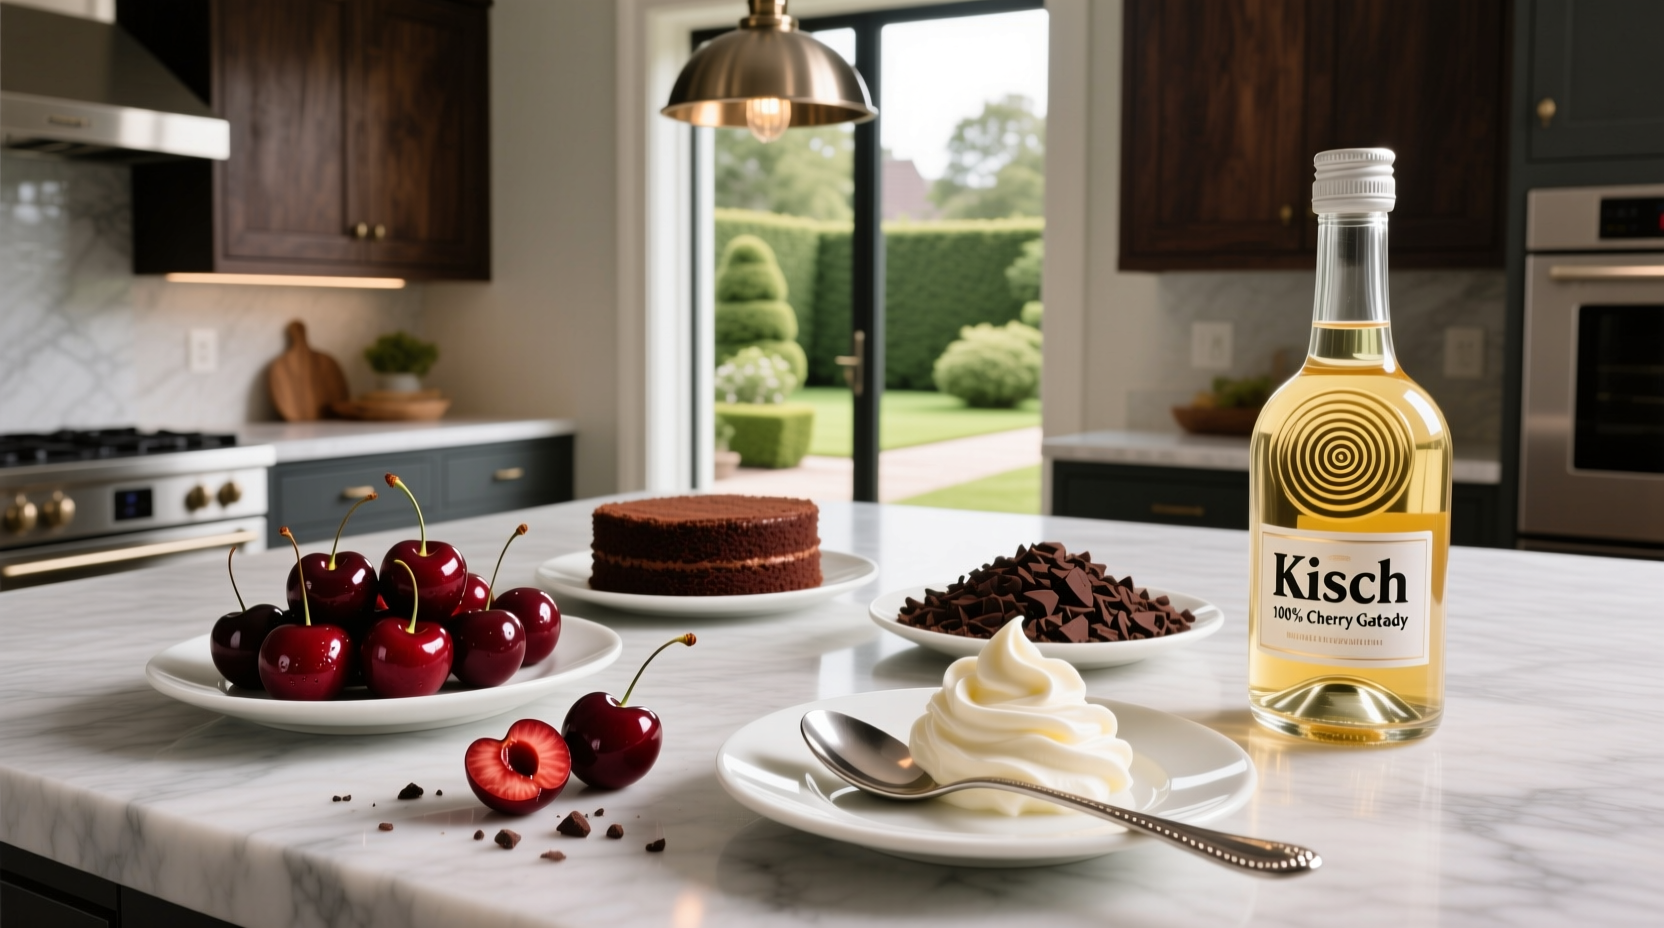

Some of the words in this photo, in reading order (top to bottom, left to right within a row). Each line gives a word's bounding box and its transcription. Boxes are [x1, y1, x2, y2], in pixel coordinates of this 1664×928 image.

[1273, 552, 1409, 604] Kisch
[1273, 605, 1303, 623] 100%
[1307, 610, 1353, 630] Cherry
[1357, 612, 1408, 630] Gatady
